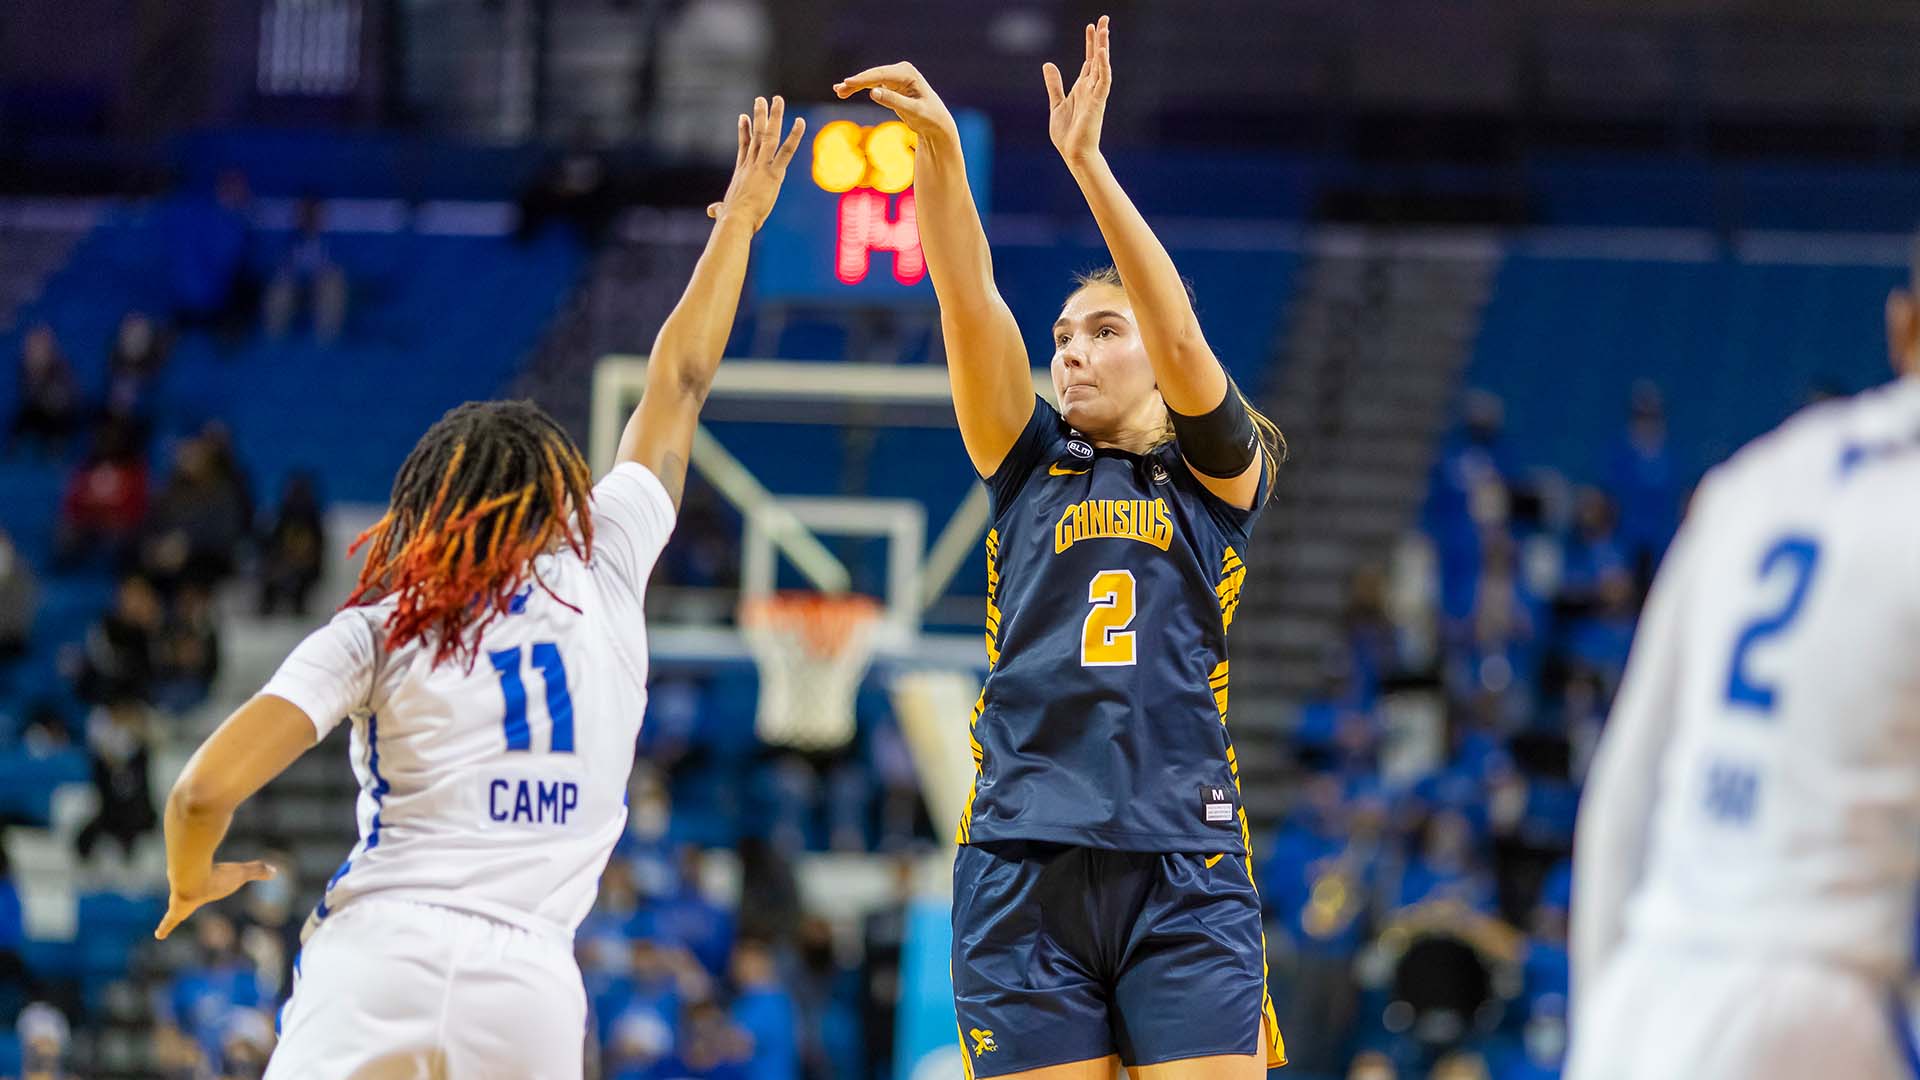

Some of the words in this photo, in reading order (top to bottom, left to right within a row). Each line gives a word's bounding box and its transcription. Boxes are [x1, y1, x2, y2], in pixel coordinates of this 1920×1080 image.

[1055, 498, 1174, 554] CANISIUS
[1081, 569, 1137, 667] 2
[1724, 532, 1823, 712] 2
[488, 641, 575, 753] 11
[489, 778, 578, 824] CAMP
[1211, 789, 1225, 801] M
